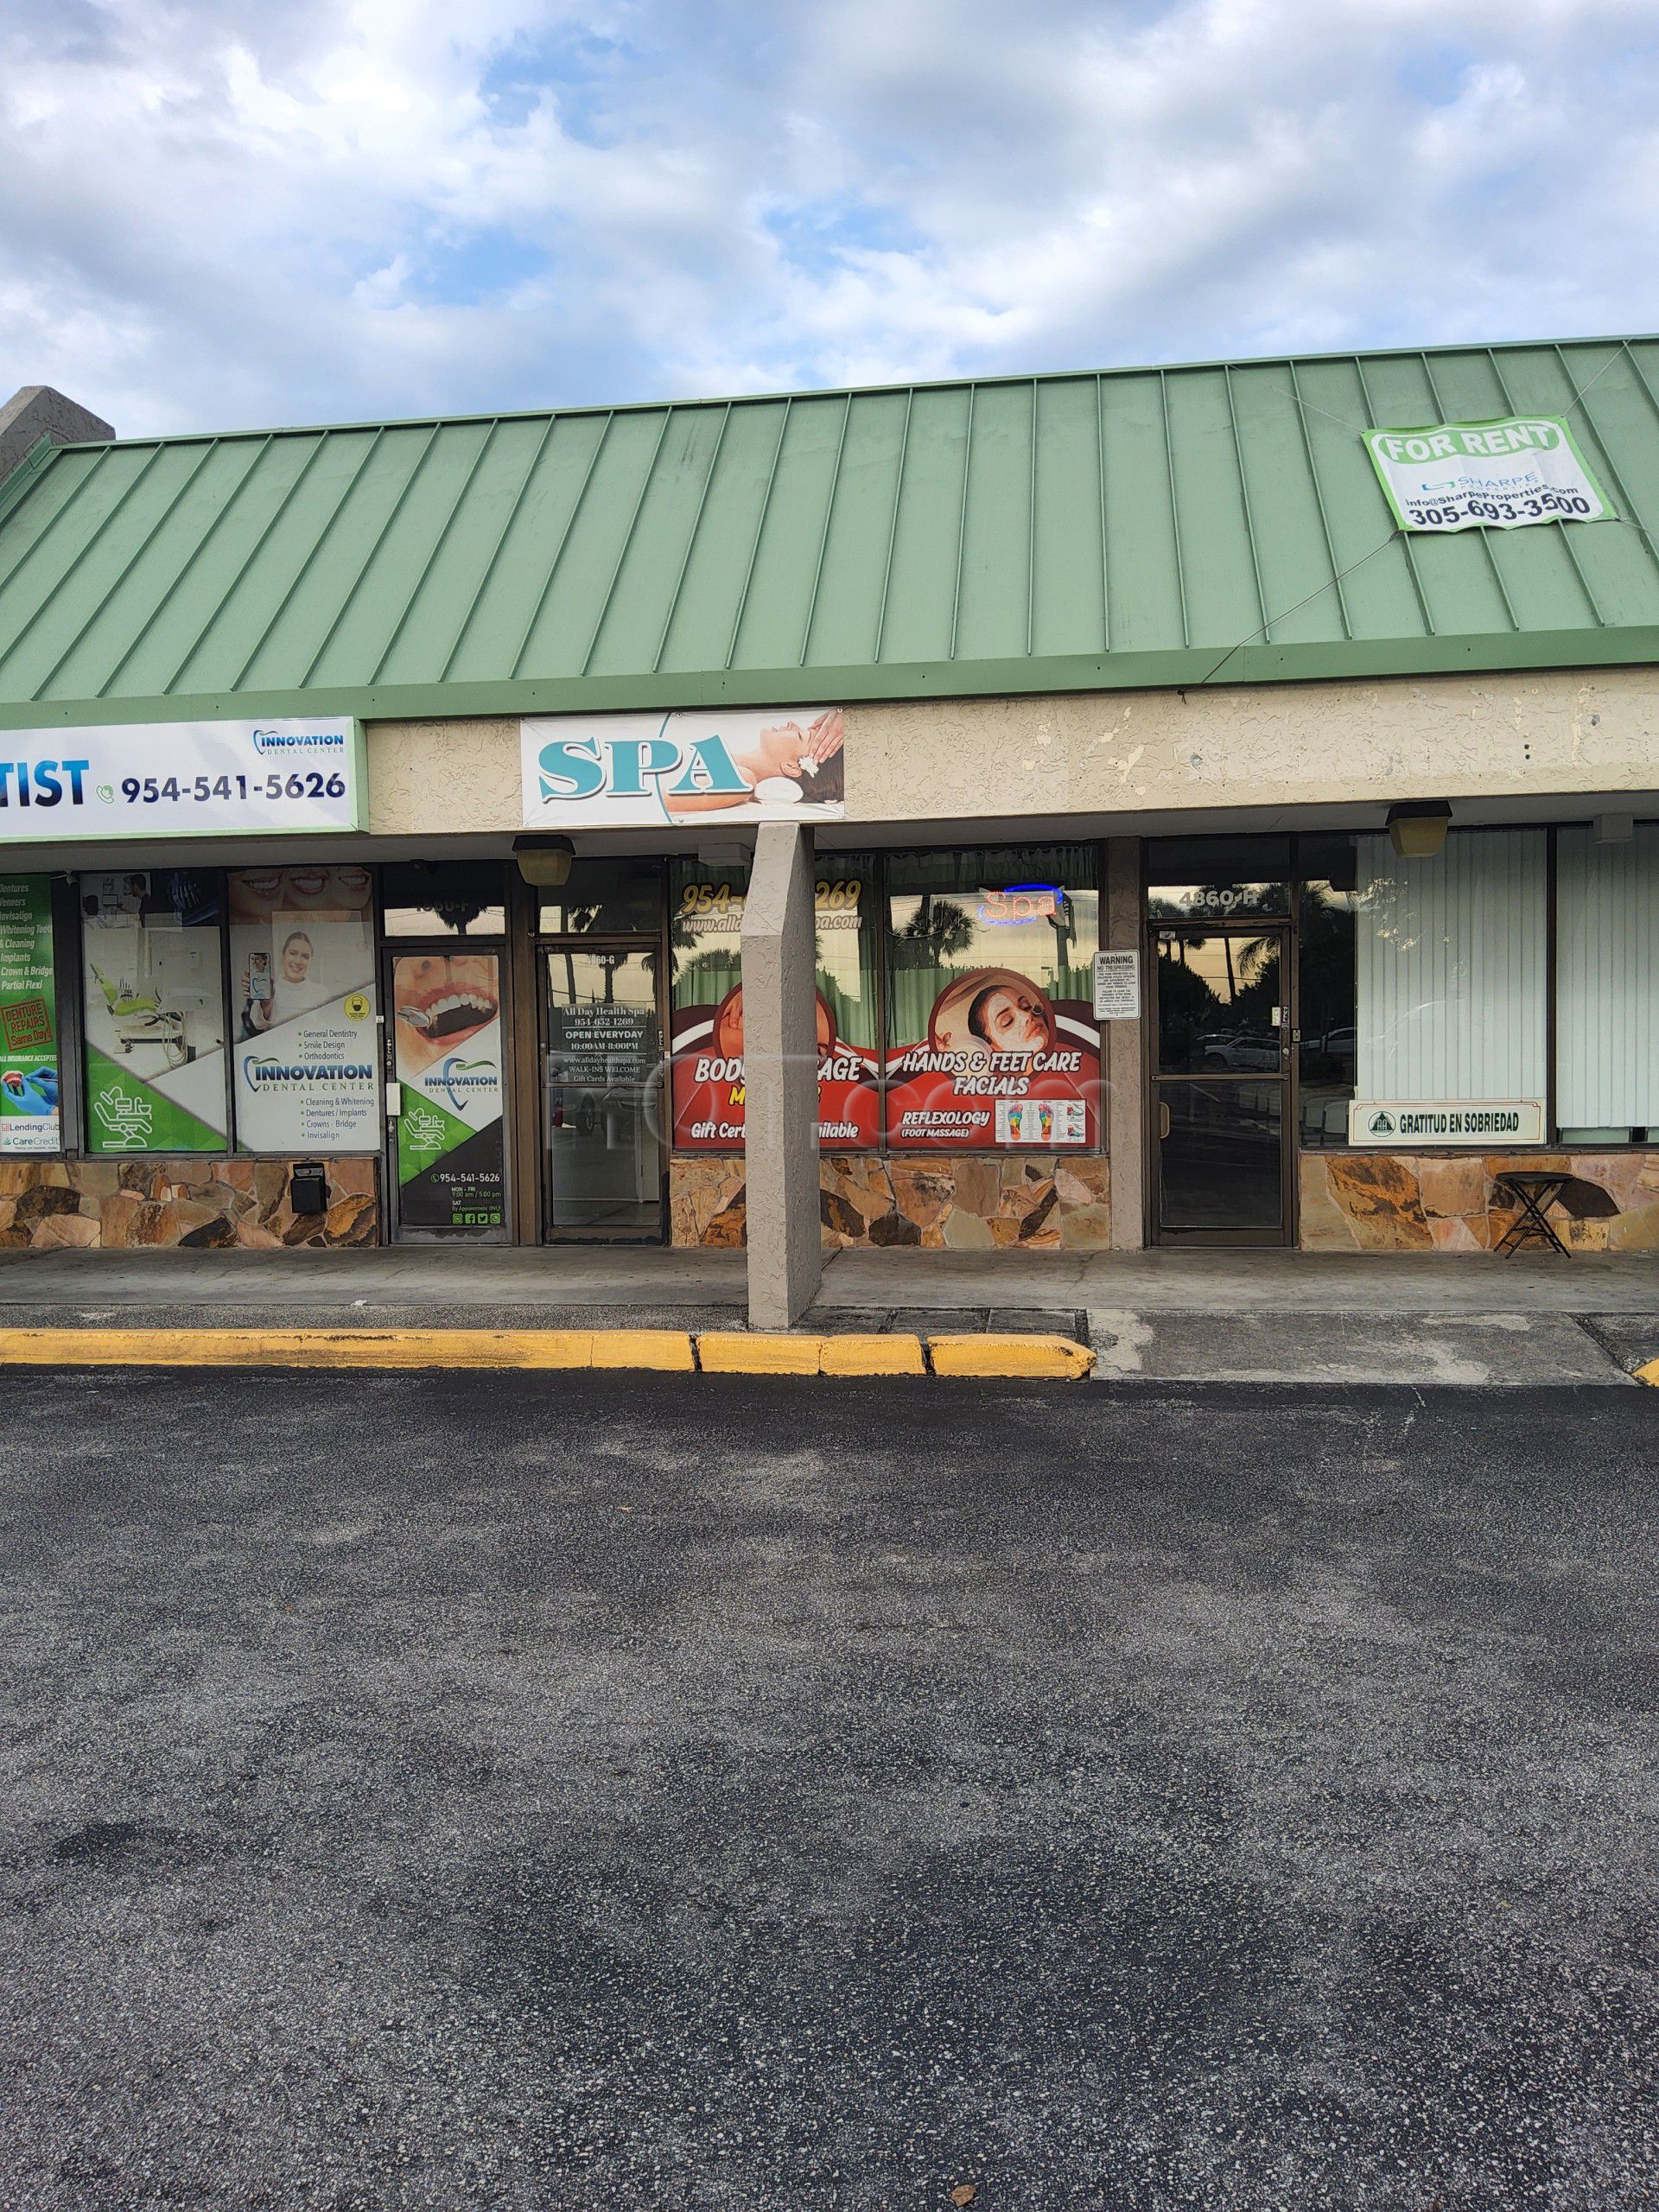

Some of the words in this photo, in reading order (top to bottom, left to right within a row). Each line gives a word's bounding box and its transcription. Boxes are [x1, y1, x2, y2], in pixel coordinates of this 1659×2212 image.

[1385, 432, 1457, 461] FOR
[1460, 424, 1549, 455] RENT
[1458, 471, 1537, 486] SHARPE
[1406, 483, 1579, 506] info@SharpeProperties.com
[1408, 493, 1591, 525] 305-693-3500
[261, 734, 344, 747] INNOVATION
[538, 734, 753, 804] SPA
[121, 772, 346, 804] 954-541-5626
[1179, 889, 1258, 907] 4860-H
[985, 891, 1056, 921] Spa
[0, 925, 35, 935] Whitening
[5, 939, 35, 949] Cleaning
[0, 953, 31, 963] Implants
[1099, 955, 1134, 965] WARNING
[1, 967, 23, 976] Crown
[23, 966, 29, 976] &
[30, 966, 54, 977] Bridge
[2, 980, 24, 990] Partial
[26, 980, 43, 989] Flexi
[6, 1002, 43, 1021] DENTURE
[563, 1007, 577, 1016] All
[577, 1007, 594, 1018] Day
[596, 1007, 626, 1016] Health
[628, 1007, 645, 1017] Spa
[10, 1015, 45, 1033] REPAIRS
[574, 1017, 634, 1027] 954-652-1269
[11, 1033, 33, 1046] Same
[329, 1029, 358, 1039] Dentistry
[565, 1031, 592, 1039] OPEN
[594, 1031, 644, 1039] EVERYDAY
[304, 1040, 322, 1049] Smile
[323, 1040, 346, 1051] Design
[571, 1042, 639, 1051] 10:00AM-8:00PM
[304, 1052, 345, 1060] Orthodontics
[563, 1056, 646, 1065] www.alldayhealthspa.com
[902, 1052, 967, 1071] HANDS
[969, 1052, 986, 1071] &
[989, 1052, 1033, 1071] FEET
[1033, 1051, 1082, 1071] CARE
[255, 1065, 373, 1081] INNOVATION
[263, 1083, 315, 1091] DENTAL
[321, 1082, 374, 1091] CENTER
[424, 1076, 498, 1086] INNOVATION
[953, 1076, 1029, 1096] FACIALS
[306, 1097, 334, 1108] Cleaning
[334, 1097, 340, 1106] &
[341, 1097, 374, 1107] Whitening
[306, 1109, 334, 1117] Dentures
[340, 1109, 367, 1118] Implants
[901, 1110, 990, 1127] REFLEXOLOGY
[10, 1123, 60, 1132] LendingClub
[306, 1119, 330, 1128] Crowns
[335, 1119, 357, 1129] Bridge
[1400, 1113, 1446, 1134] GRATITUD
[1449, 1113, 1462, 1133] EN
[1465, 1112, 1519, 1133] SOBRIEDAD
[307, 1130, 340, 1141] Invisalign
[691, 1122, 716, 1139] Gift
[901, 1128, 925, 1138] (FOOT
[926, 1128, 969, 1138] MASSAGE)
[12, 1136, 59, 1145] CareCredit
[440, 1173, 500, 1183] 954-541-5626
